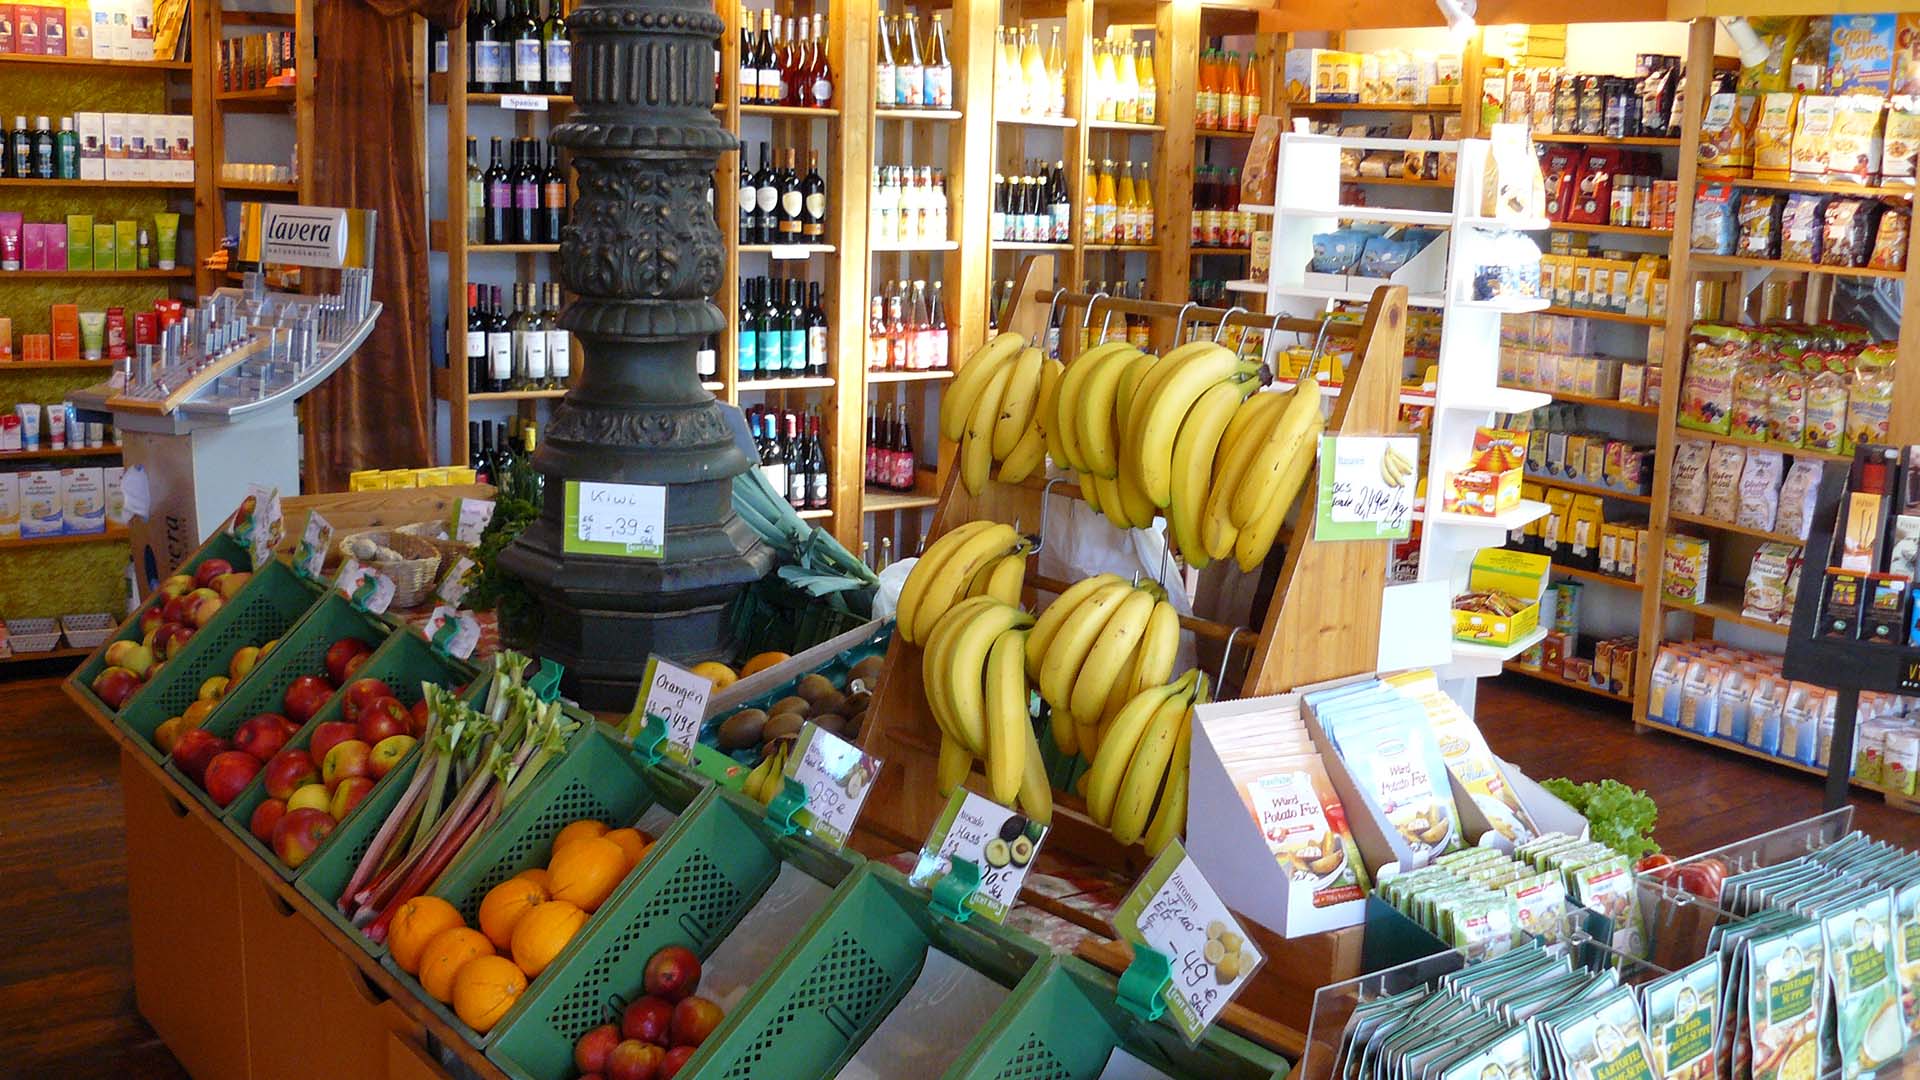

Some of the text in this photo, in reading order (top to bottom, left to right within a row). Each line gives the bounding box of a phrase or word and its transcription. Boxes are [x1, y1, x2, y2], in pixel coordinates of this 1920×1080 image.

[268, 214, 331, 243] lavera
[591, 489, 637, 505] Kiwi
[656, 673, 703, 708] Orangen
[1264, 802, 1319, 824] Potato Fix
[1171, 872, 1199, 912] Zitronen
